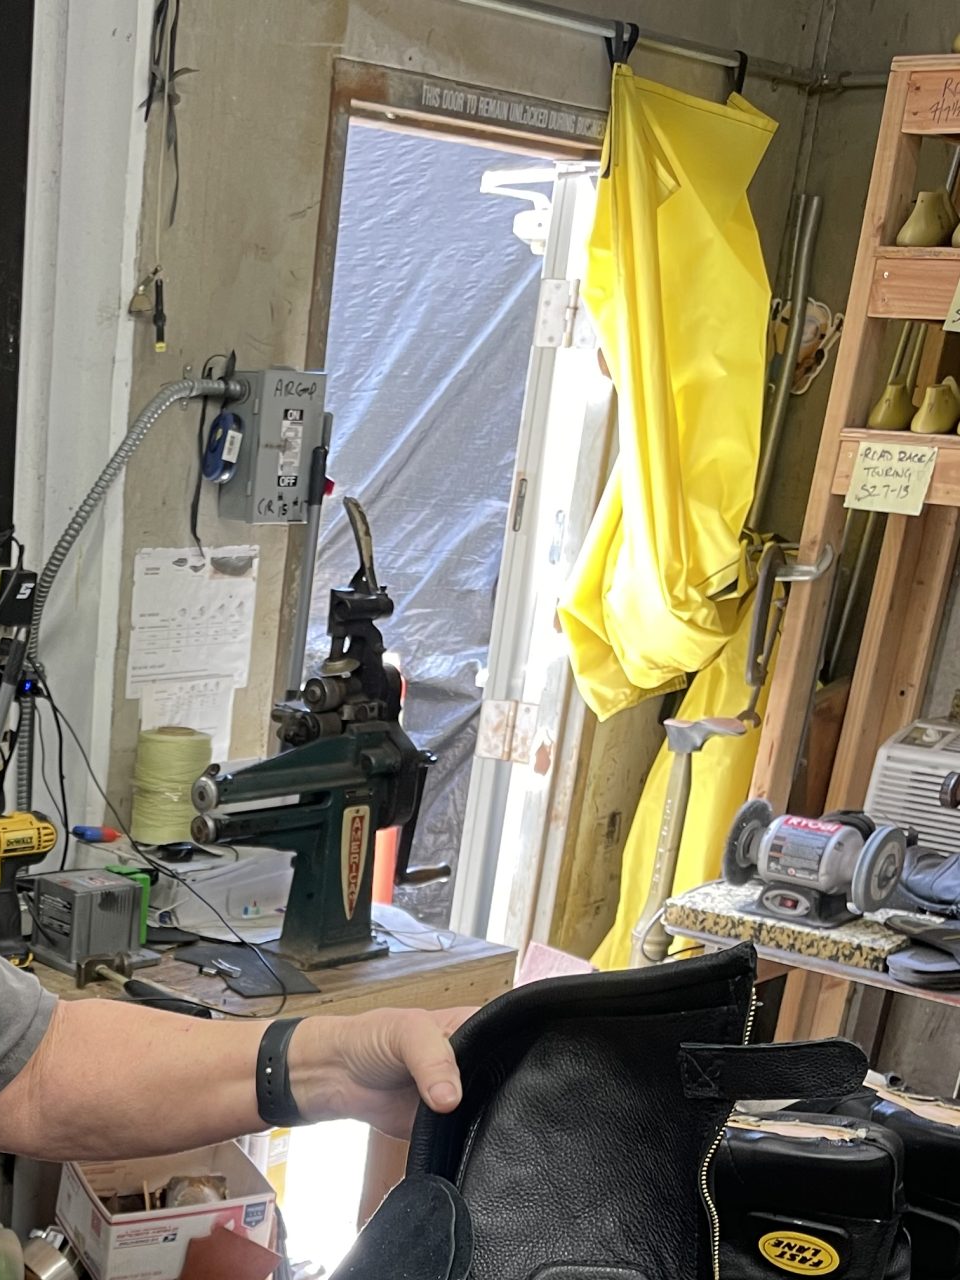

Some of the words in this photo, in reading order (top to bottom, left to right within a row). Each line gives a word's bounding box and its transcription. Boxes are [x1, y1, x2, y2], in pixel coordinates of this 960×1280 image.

[421, 84, 440, 107] THIS
[442, 89, 464, 112] DOOR
[466, 94, 477, 115] TO
[478, 96, 509, 121] REMAIN
[548, 110, 576, 133] DURING
[287, 409, 301, 421] ON
[279, 476, 296, 487] OFF
[786, 815, 840, 833] RYOBI
[770, 1238, 822, 1258] LANE
[774, 1250, 824, 1268] FAST
